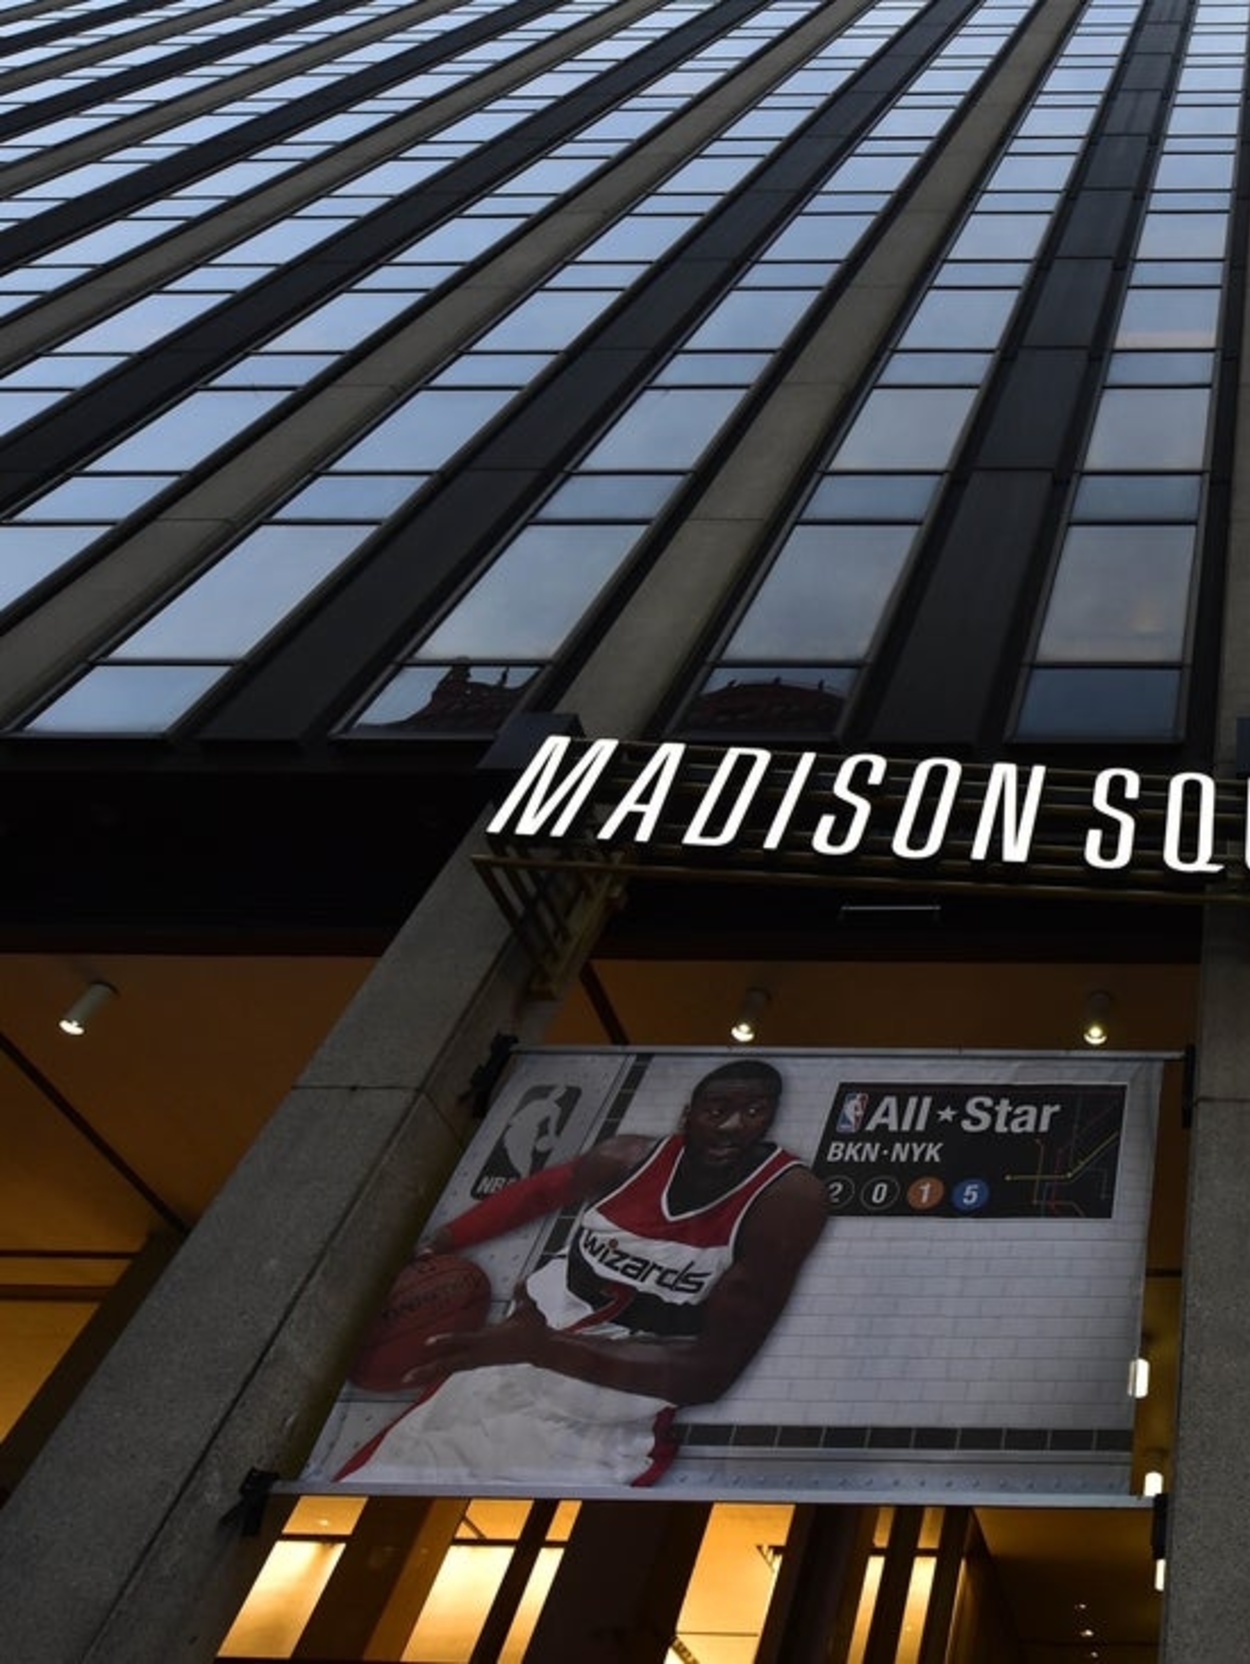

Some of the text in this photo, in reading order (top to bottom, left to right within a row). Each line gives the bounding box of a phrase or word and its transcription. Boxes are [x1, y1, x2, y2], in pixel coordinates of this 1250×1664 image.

[486, 735, 1046, 862] MADISON
[865, 1095, 1061, 1133] All Star
